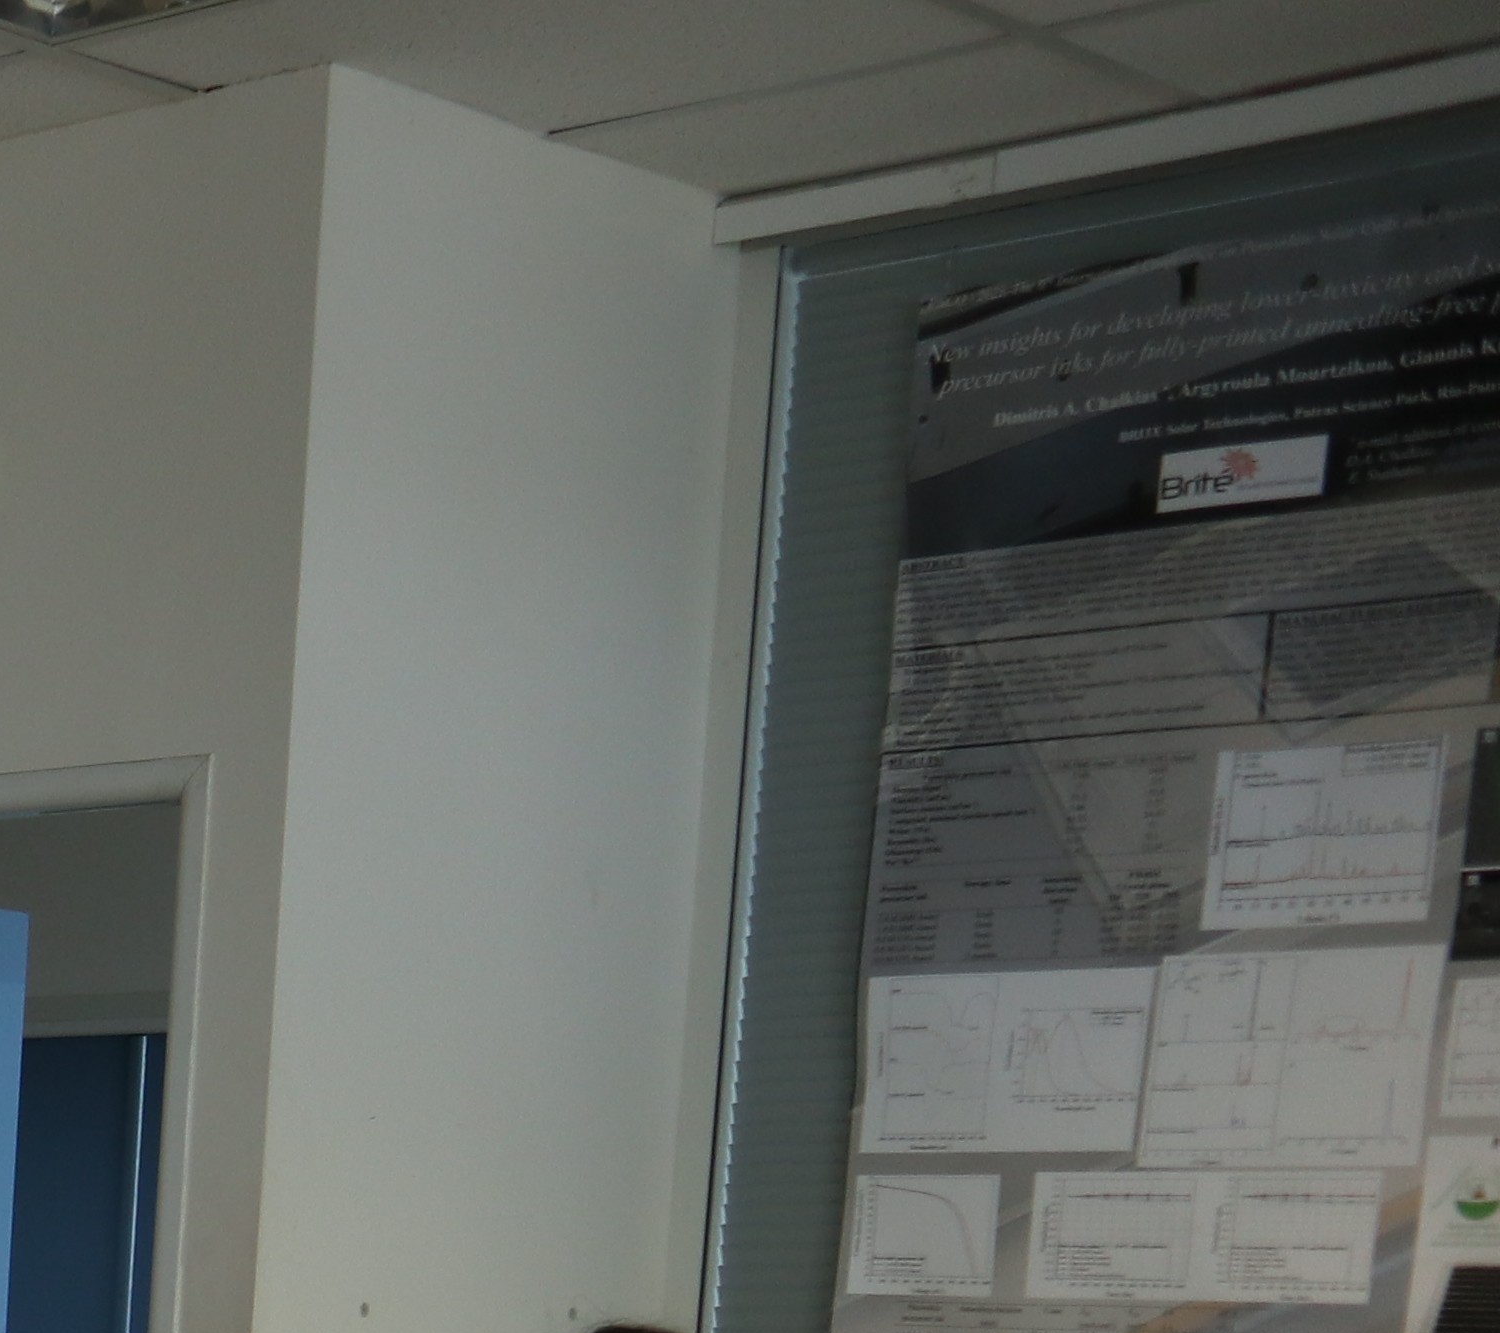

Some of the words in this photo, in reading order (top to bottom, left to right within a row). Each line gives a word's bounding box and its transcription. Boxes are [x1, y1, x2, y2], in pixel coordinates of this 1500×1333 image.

[980, 326, 1061, 357] insights
[1065, 320, 1102, 348] for
[1107, 303, 1233, 336] developing
[937, 363, 1046, 400] precursor
